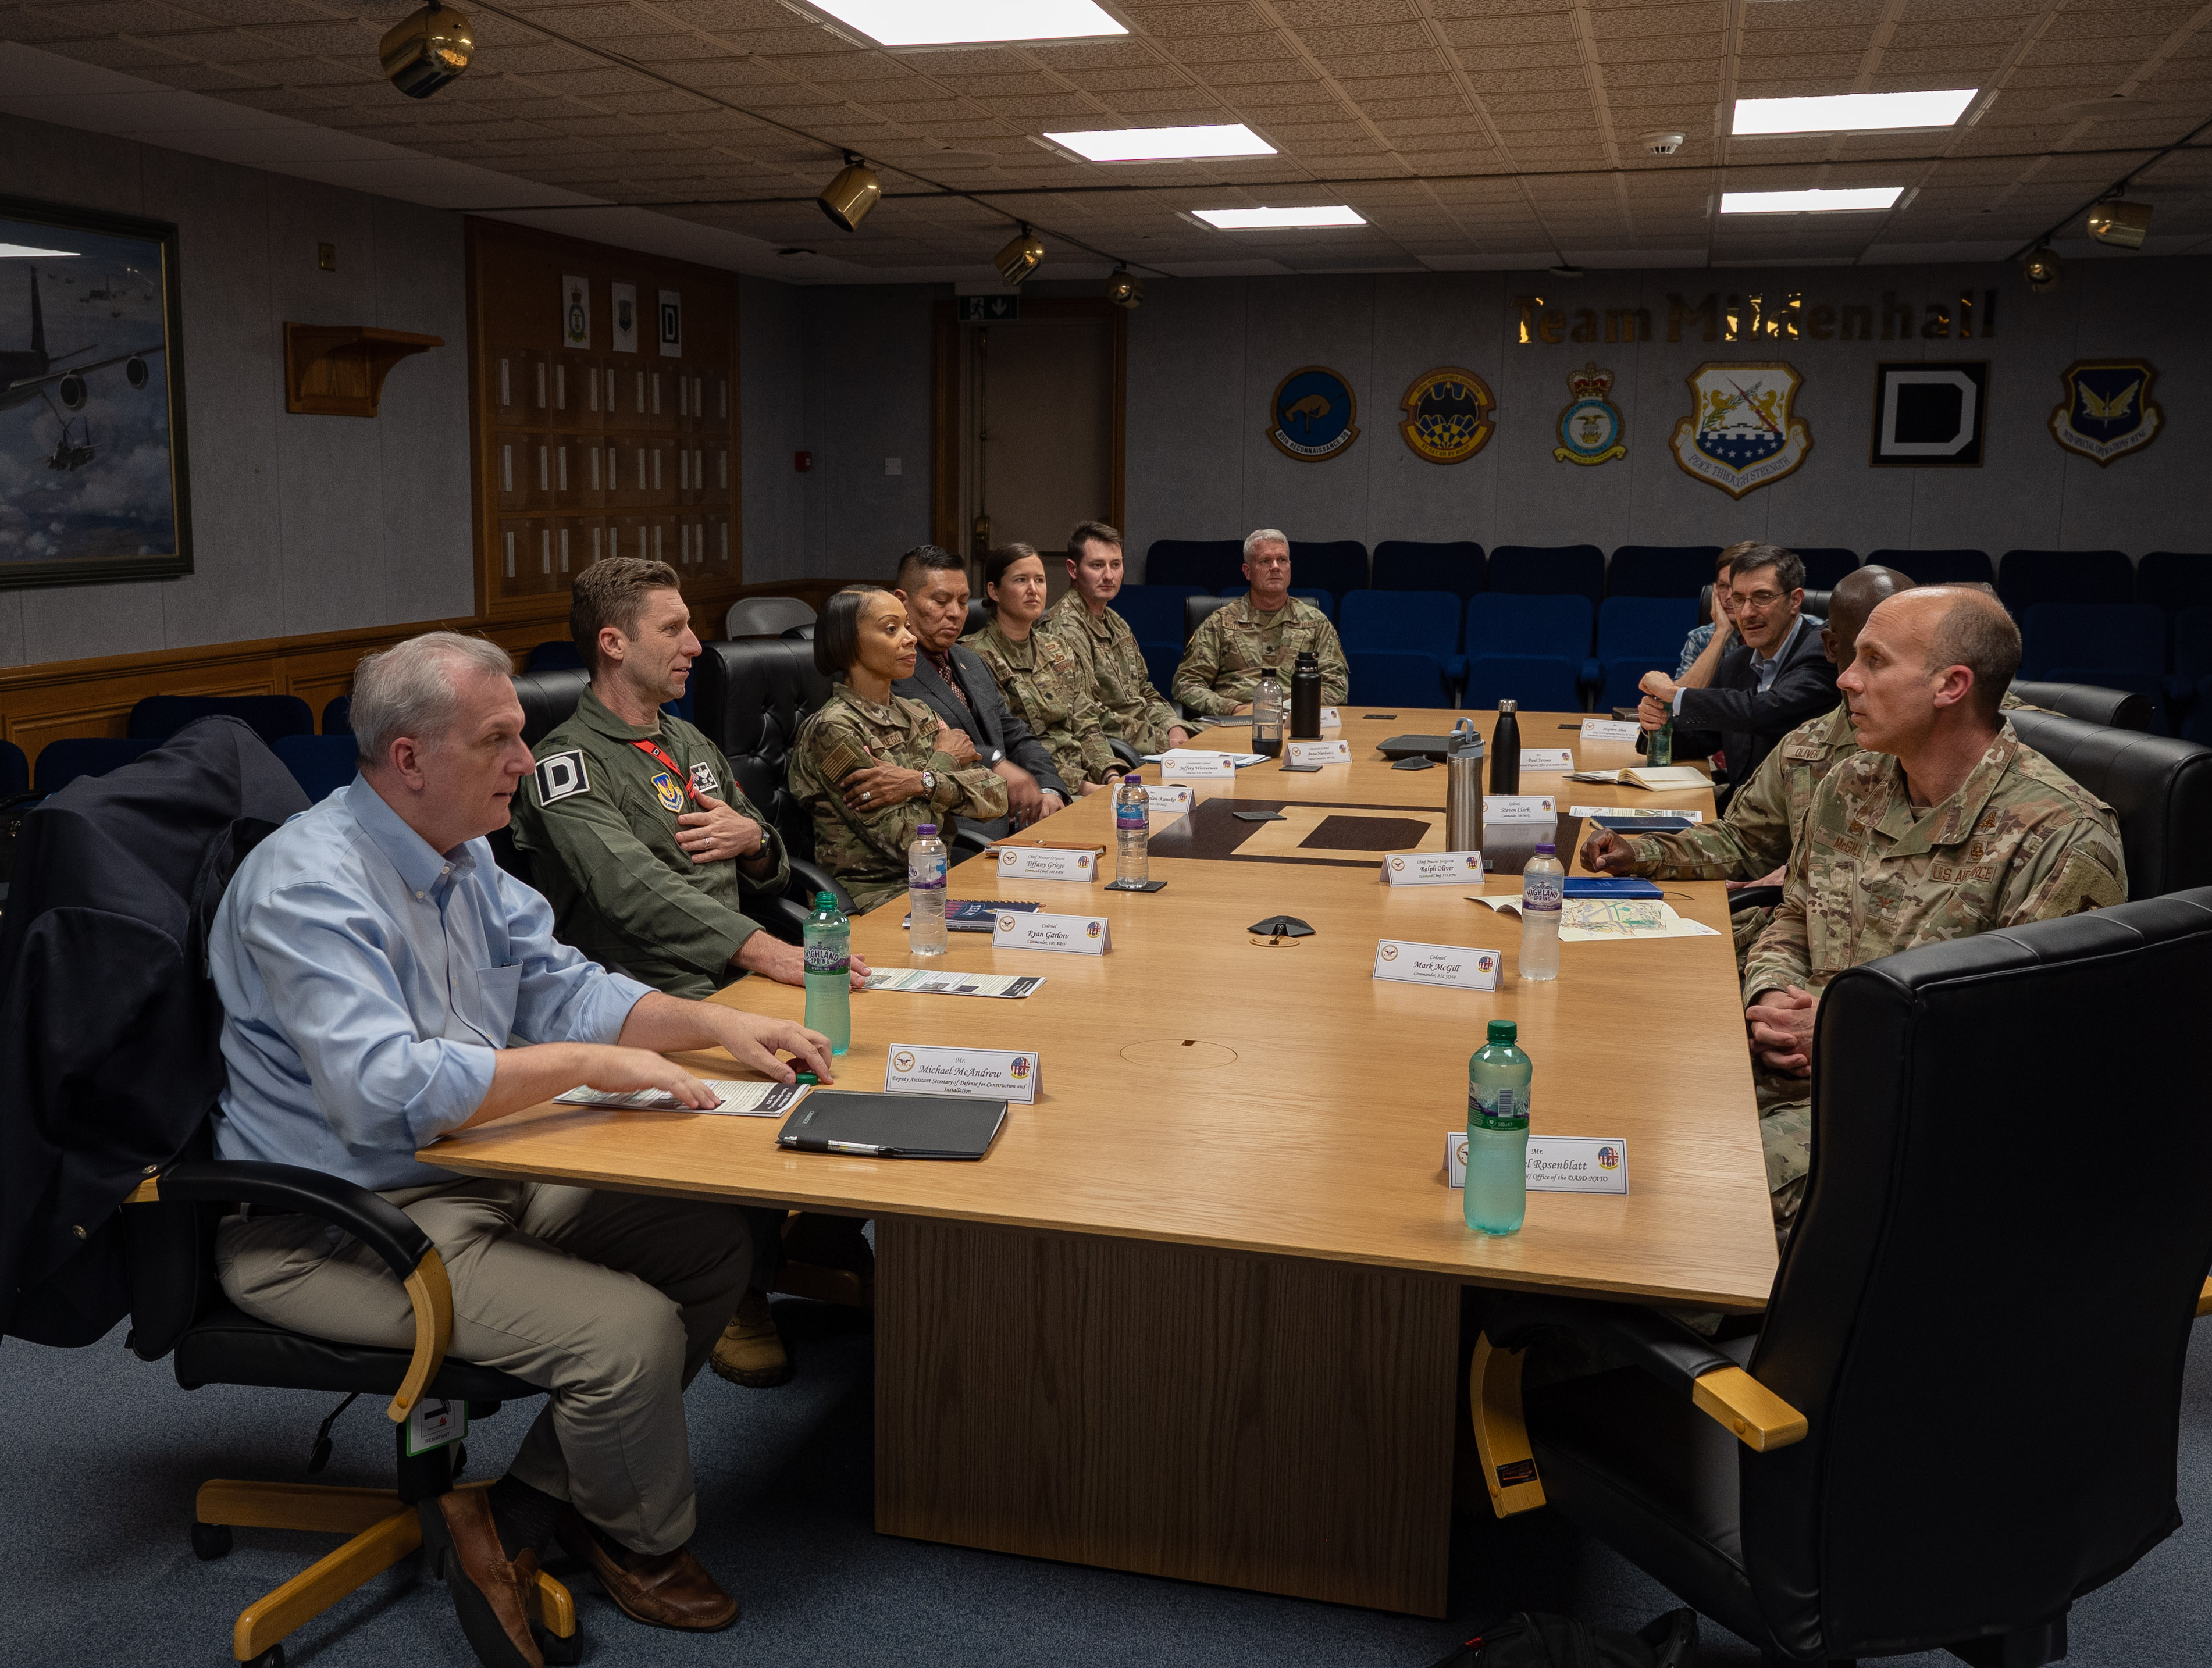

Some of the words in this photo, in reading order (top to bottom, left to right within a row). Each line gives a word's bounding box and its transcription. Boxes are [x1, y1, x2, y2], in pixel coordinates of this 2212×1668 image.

[1511, 295, 1652, 344] Team
[1666, 290, 1997, 343] Mildenhall
[1880, 371, 1977, 455] D
[1290, 439, 1341, 454] RECONNAISSANCE
[1341, 431, 1349, 440] SQ
[1688, 454, 1712, 473] PEACE
[1713, 466, 1748, 488] THROUGH
[1750, 456, 1790, 480] STRENGTH
[1794, 748, 1821, 759] OLIVER
[544, 755, 578, 798] D
[1833, 836, 1863, 858] McGILL
[1026, 860, 1047, 869] Tiffany
[1048, 862, 1066, 870] Griego
[1420, 865, 1437, 873] Ralph
[1932, 865, 1953, 881] U.S.
[1527, 889, 1558, 899] HIGHLAND
[1027, 930, 1045, 939] Ryan
[1045, 931, 1070, 939] Garlow
[805, 950, 839, 961] HIGHLAND
[1413, 961, 1434, 972] Mark
[1434, 963, 1462, 974] McGill
[918, 1065, 954, 1075] Michael
[954, 1067, 1002, 1079] McAndrew
[892, 1075, 909, 1084] Deputy
[1533, 1159, 1587, 1171] Rosenblatt
[1533, 1174, 1550, 1182] Office
[1550, 1174, 1557, 1182] of
[425, 1431, 451, 1445] RESISTANT
